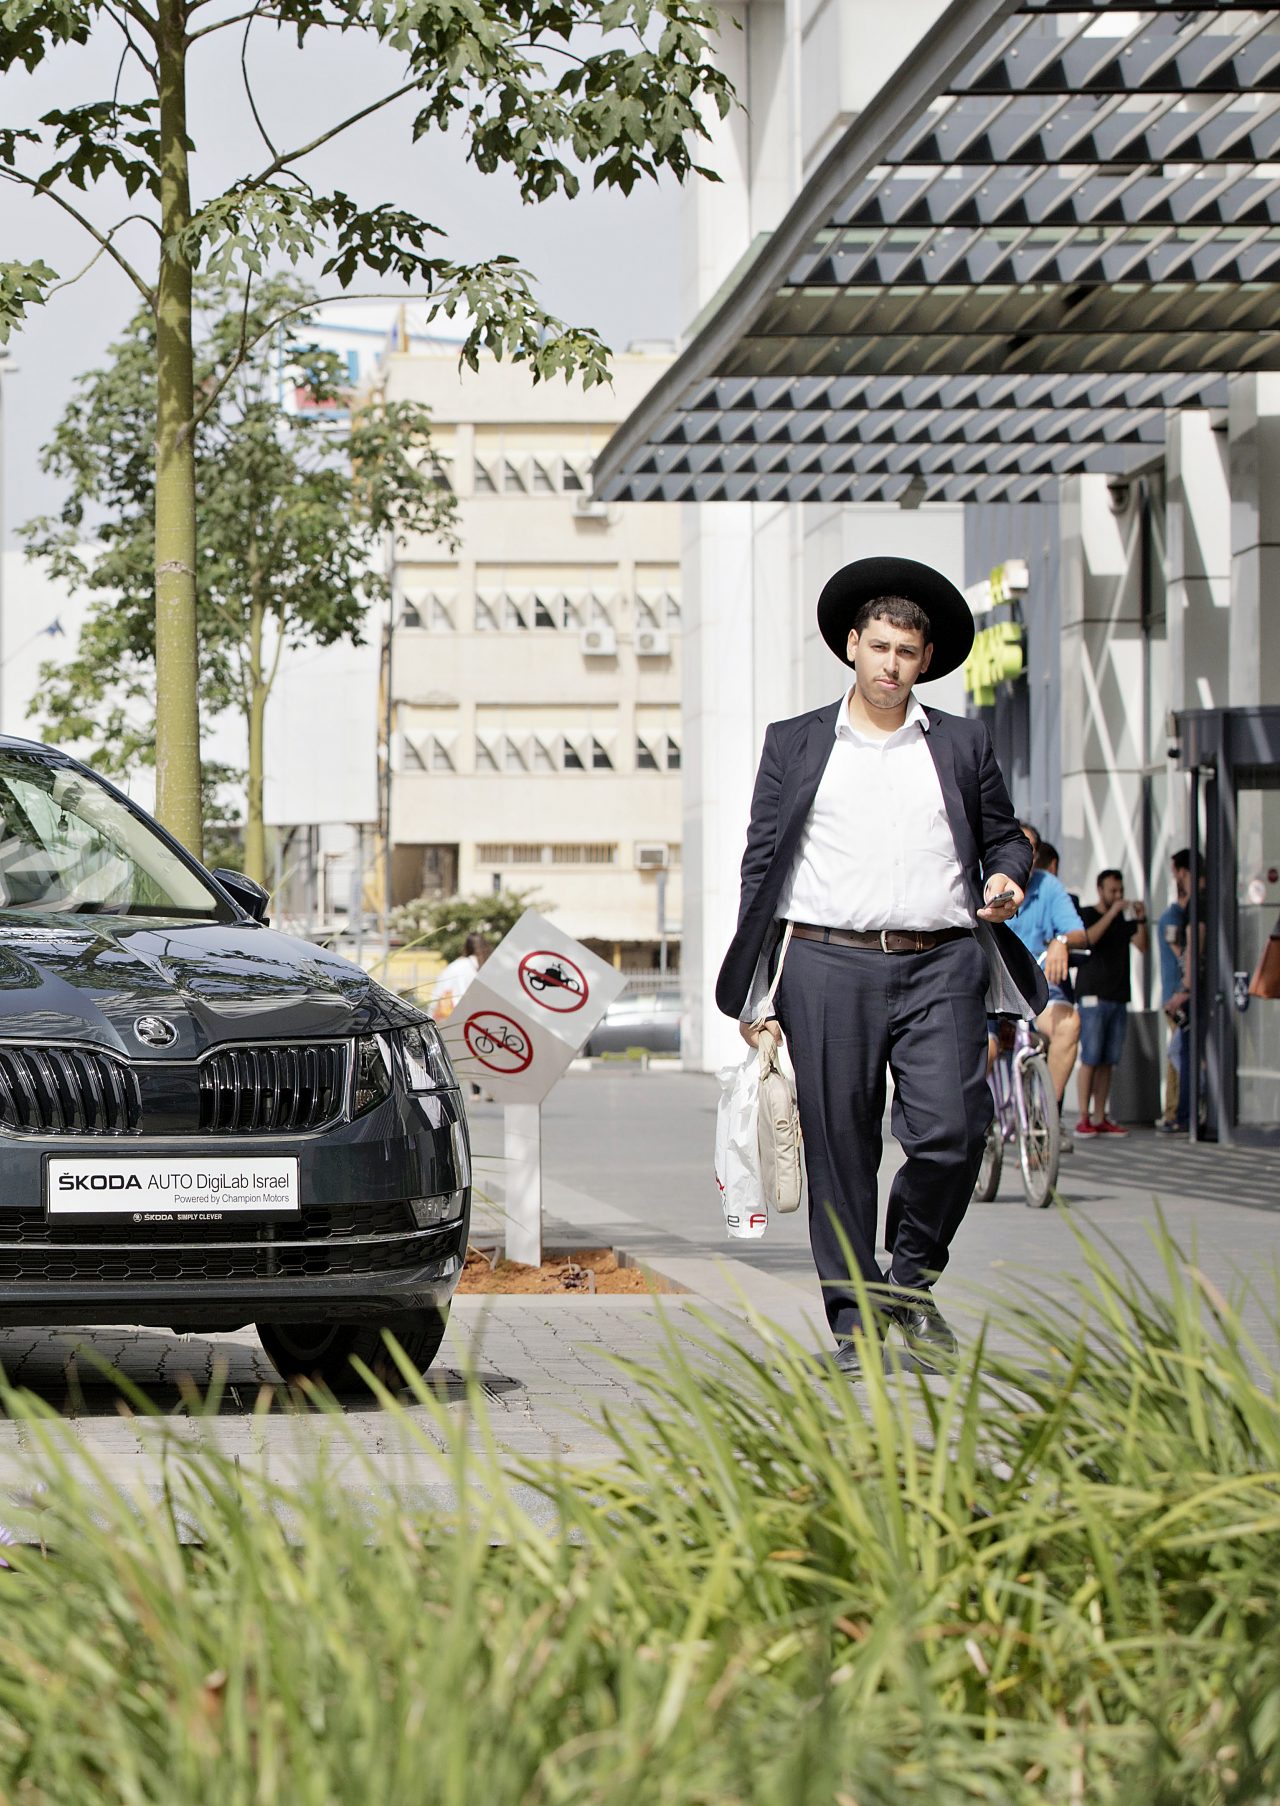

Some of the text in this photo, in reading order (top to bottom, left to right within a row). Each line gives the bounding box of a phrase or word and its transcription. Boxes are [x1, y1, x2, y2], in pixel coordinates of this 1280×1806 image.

[58, 1172, 289, 1193] ŠKODA AUTO DigiLab Israel
[173, 1193, 290, 1205] Powered by Champion Motors
[198, 1213, 223, 1221] CLEVER
